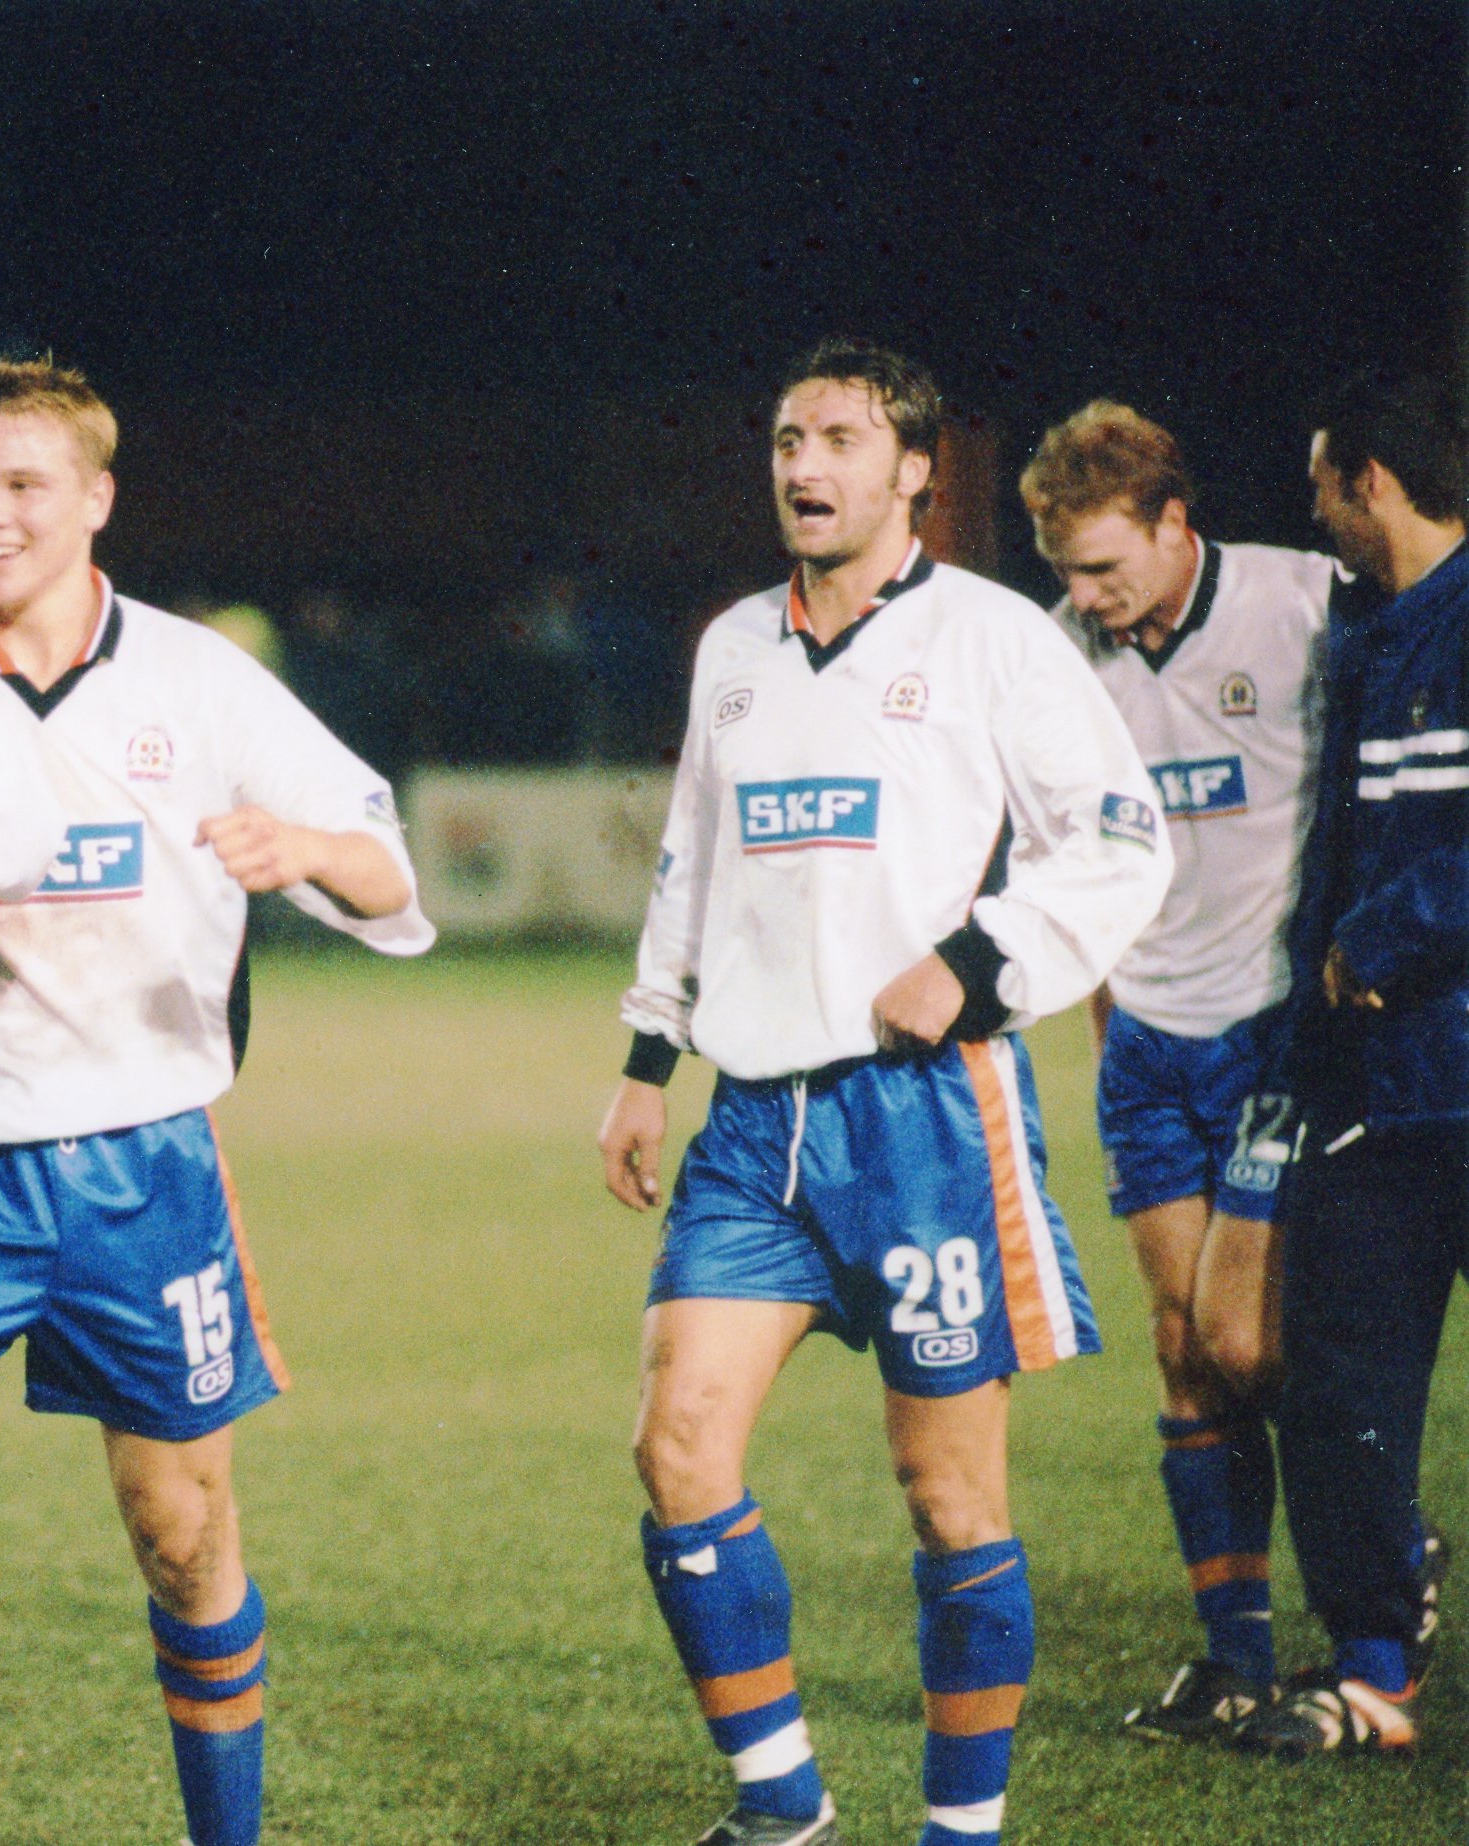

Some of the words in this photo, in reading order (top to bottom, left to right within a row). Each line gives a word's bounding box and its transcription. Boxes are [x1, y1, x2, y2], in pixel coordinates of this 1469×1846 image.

[718, 697, 747, 720] OS
[747, 789, 867, 836] SKF
[883, 1236, 984, 1333] 28
[162, 1260, 232, 1367] 15
[922, 1336, 970, 1360] OS
[197, 1361, 231, 1392] OS
